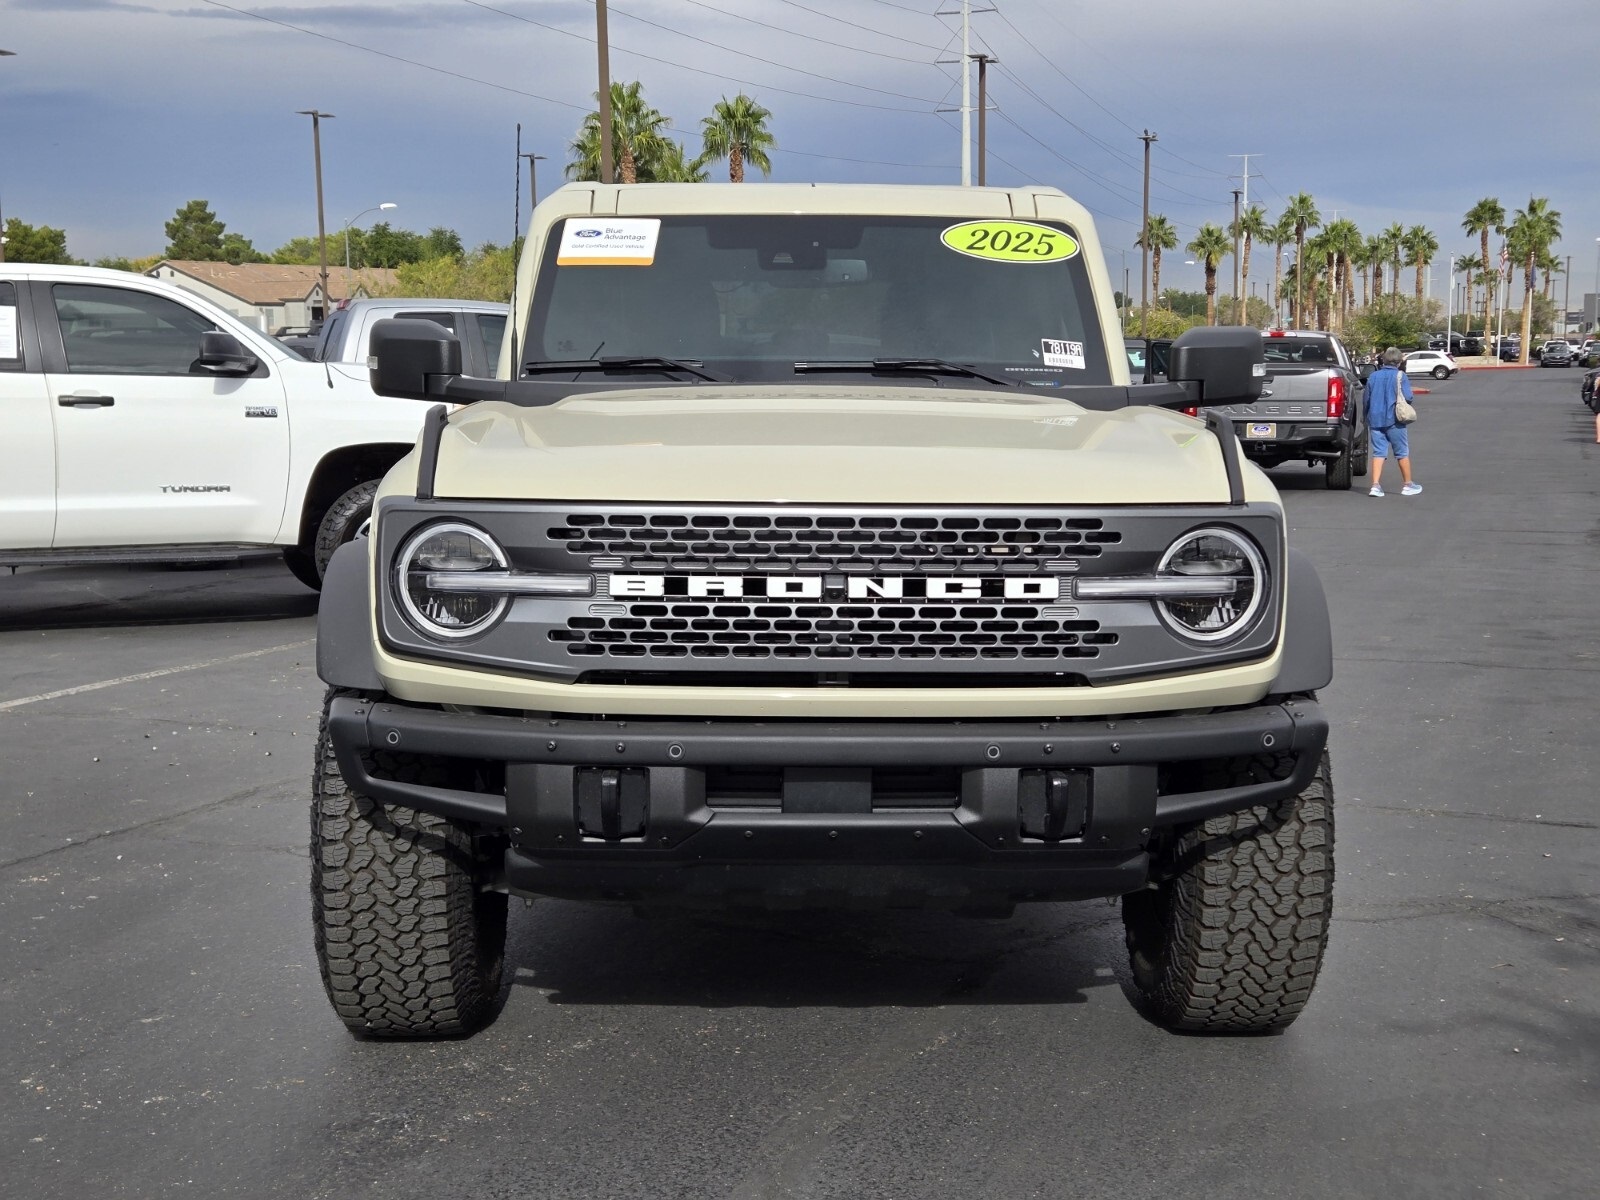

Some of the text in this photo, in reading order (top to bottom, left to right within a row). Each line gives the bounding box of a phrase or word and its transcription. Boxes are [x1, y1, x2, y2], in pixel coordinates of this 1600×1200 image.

[966, 229, 1056, 256] 2025
[159, 485, 231, 493] TUNDRA
[609, 575, 1059, 598] BRONCO
